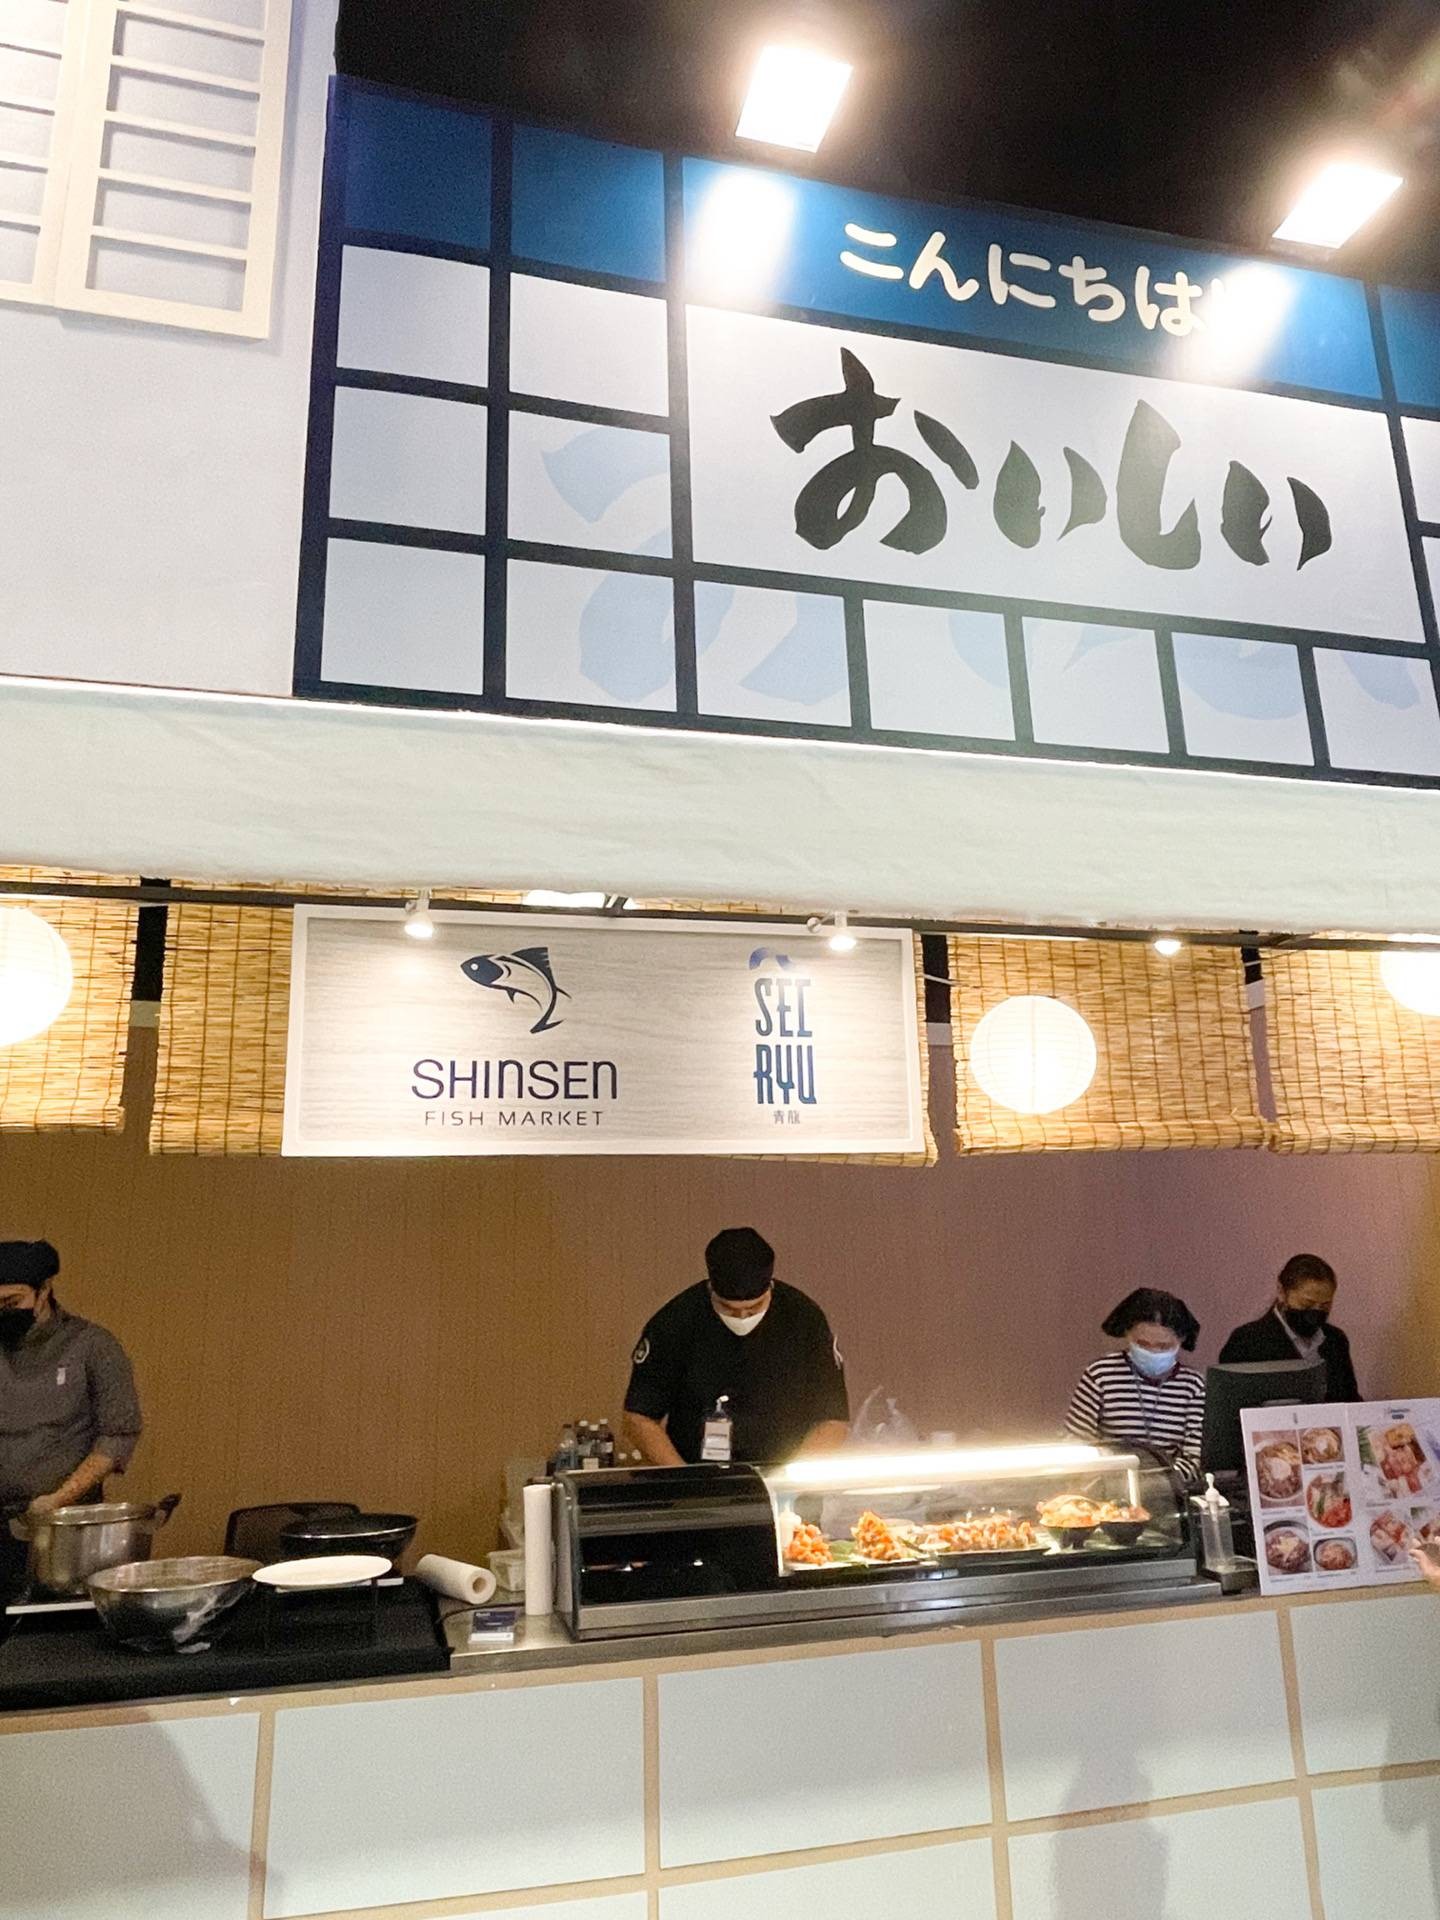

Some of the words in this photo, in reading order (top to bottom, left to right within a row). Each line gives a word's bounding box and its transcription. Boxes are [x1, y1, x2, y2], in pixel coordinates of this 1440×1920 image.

[840, 223, 1224, 337] こんにちは
[770, 347, 1332, 571] おいしい
[754, 977, 813, 1037] SEI
[753, 1043, 817, 1104] RYU
[425, 1110, 484, 1126] FISH
[498, 1110, 604, 1126] MARKET
